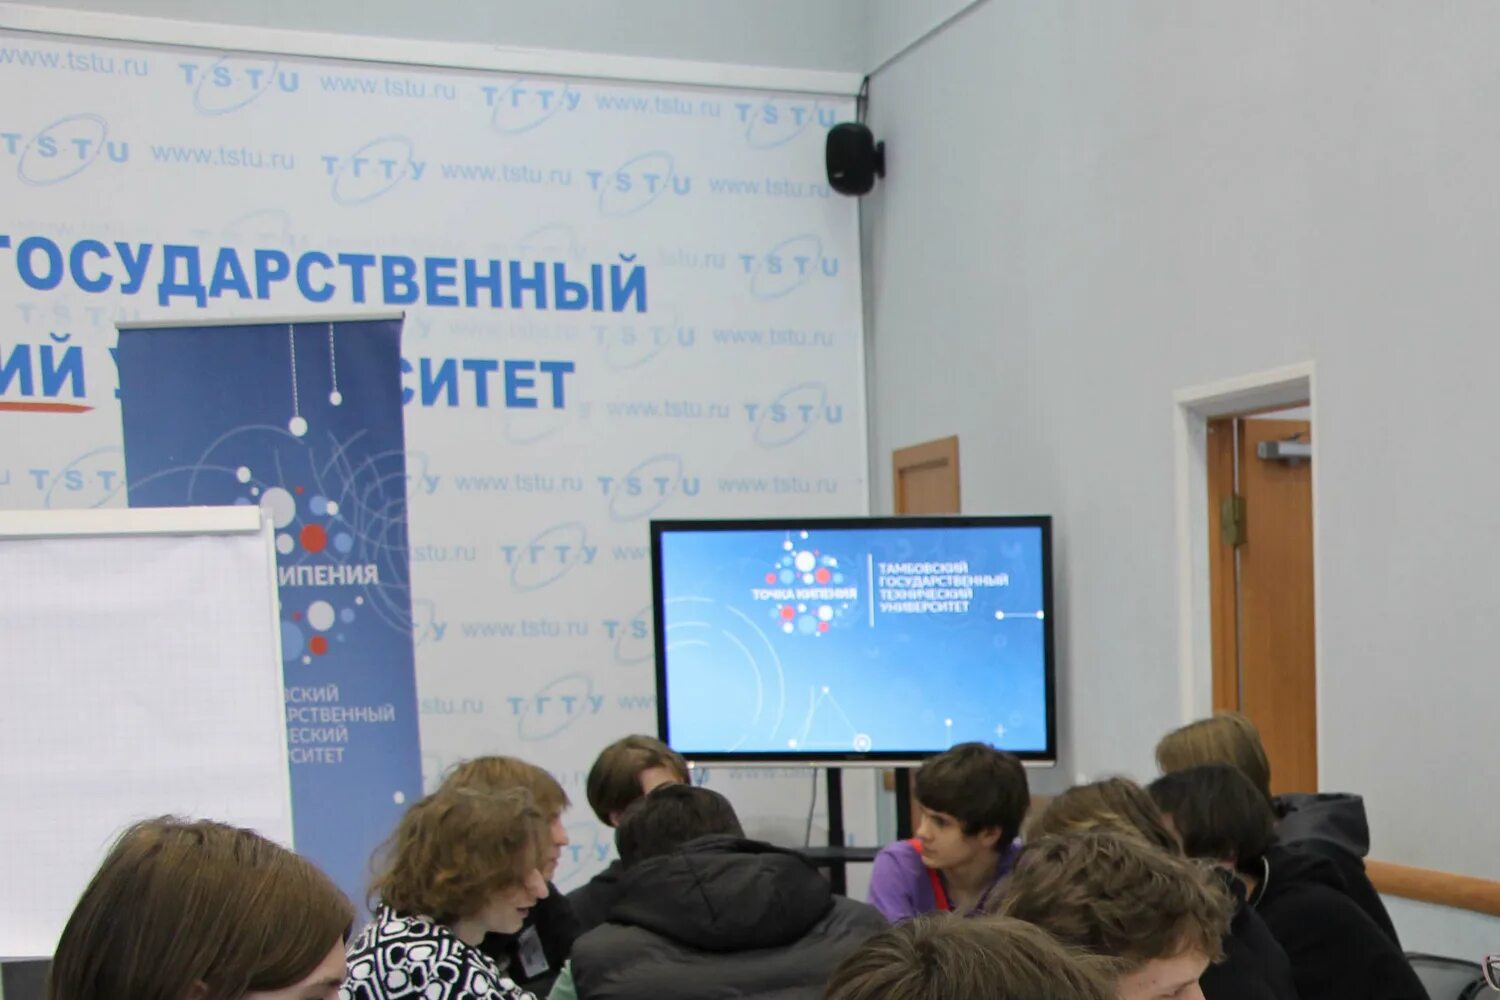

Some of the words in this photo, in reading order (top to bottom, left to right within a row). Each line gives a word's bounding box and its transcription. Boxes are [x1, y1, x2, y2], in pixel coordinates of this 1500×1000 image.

[320, 75, 456, 101] www.tstu.ru
[595, 93, 721, 118] www.tstu.ru
[151, 142, 295, 171] www.tstu.ru
[441, 161, 571, 187] www.tstu.ru
[713, 327, 833, 348] www.tstu.ru
[29, 468, 118, 492] TST
[455, 472, 582, 493] www.tstu.ru
[718, 474, 837, 494] www.tstu.ru
[278, 564, 379, 587] ИПЕНИЯ
[878, 561, 968, 574] ТАМБОВСКИЙ
[879, 573, 1009, 587] ГОСУДАРСТВЕННЫЙ
[752, 588, 796, 601] ТОЧКА
[462, 619, 589, 637] www.tstu.ru
